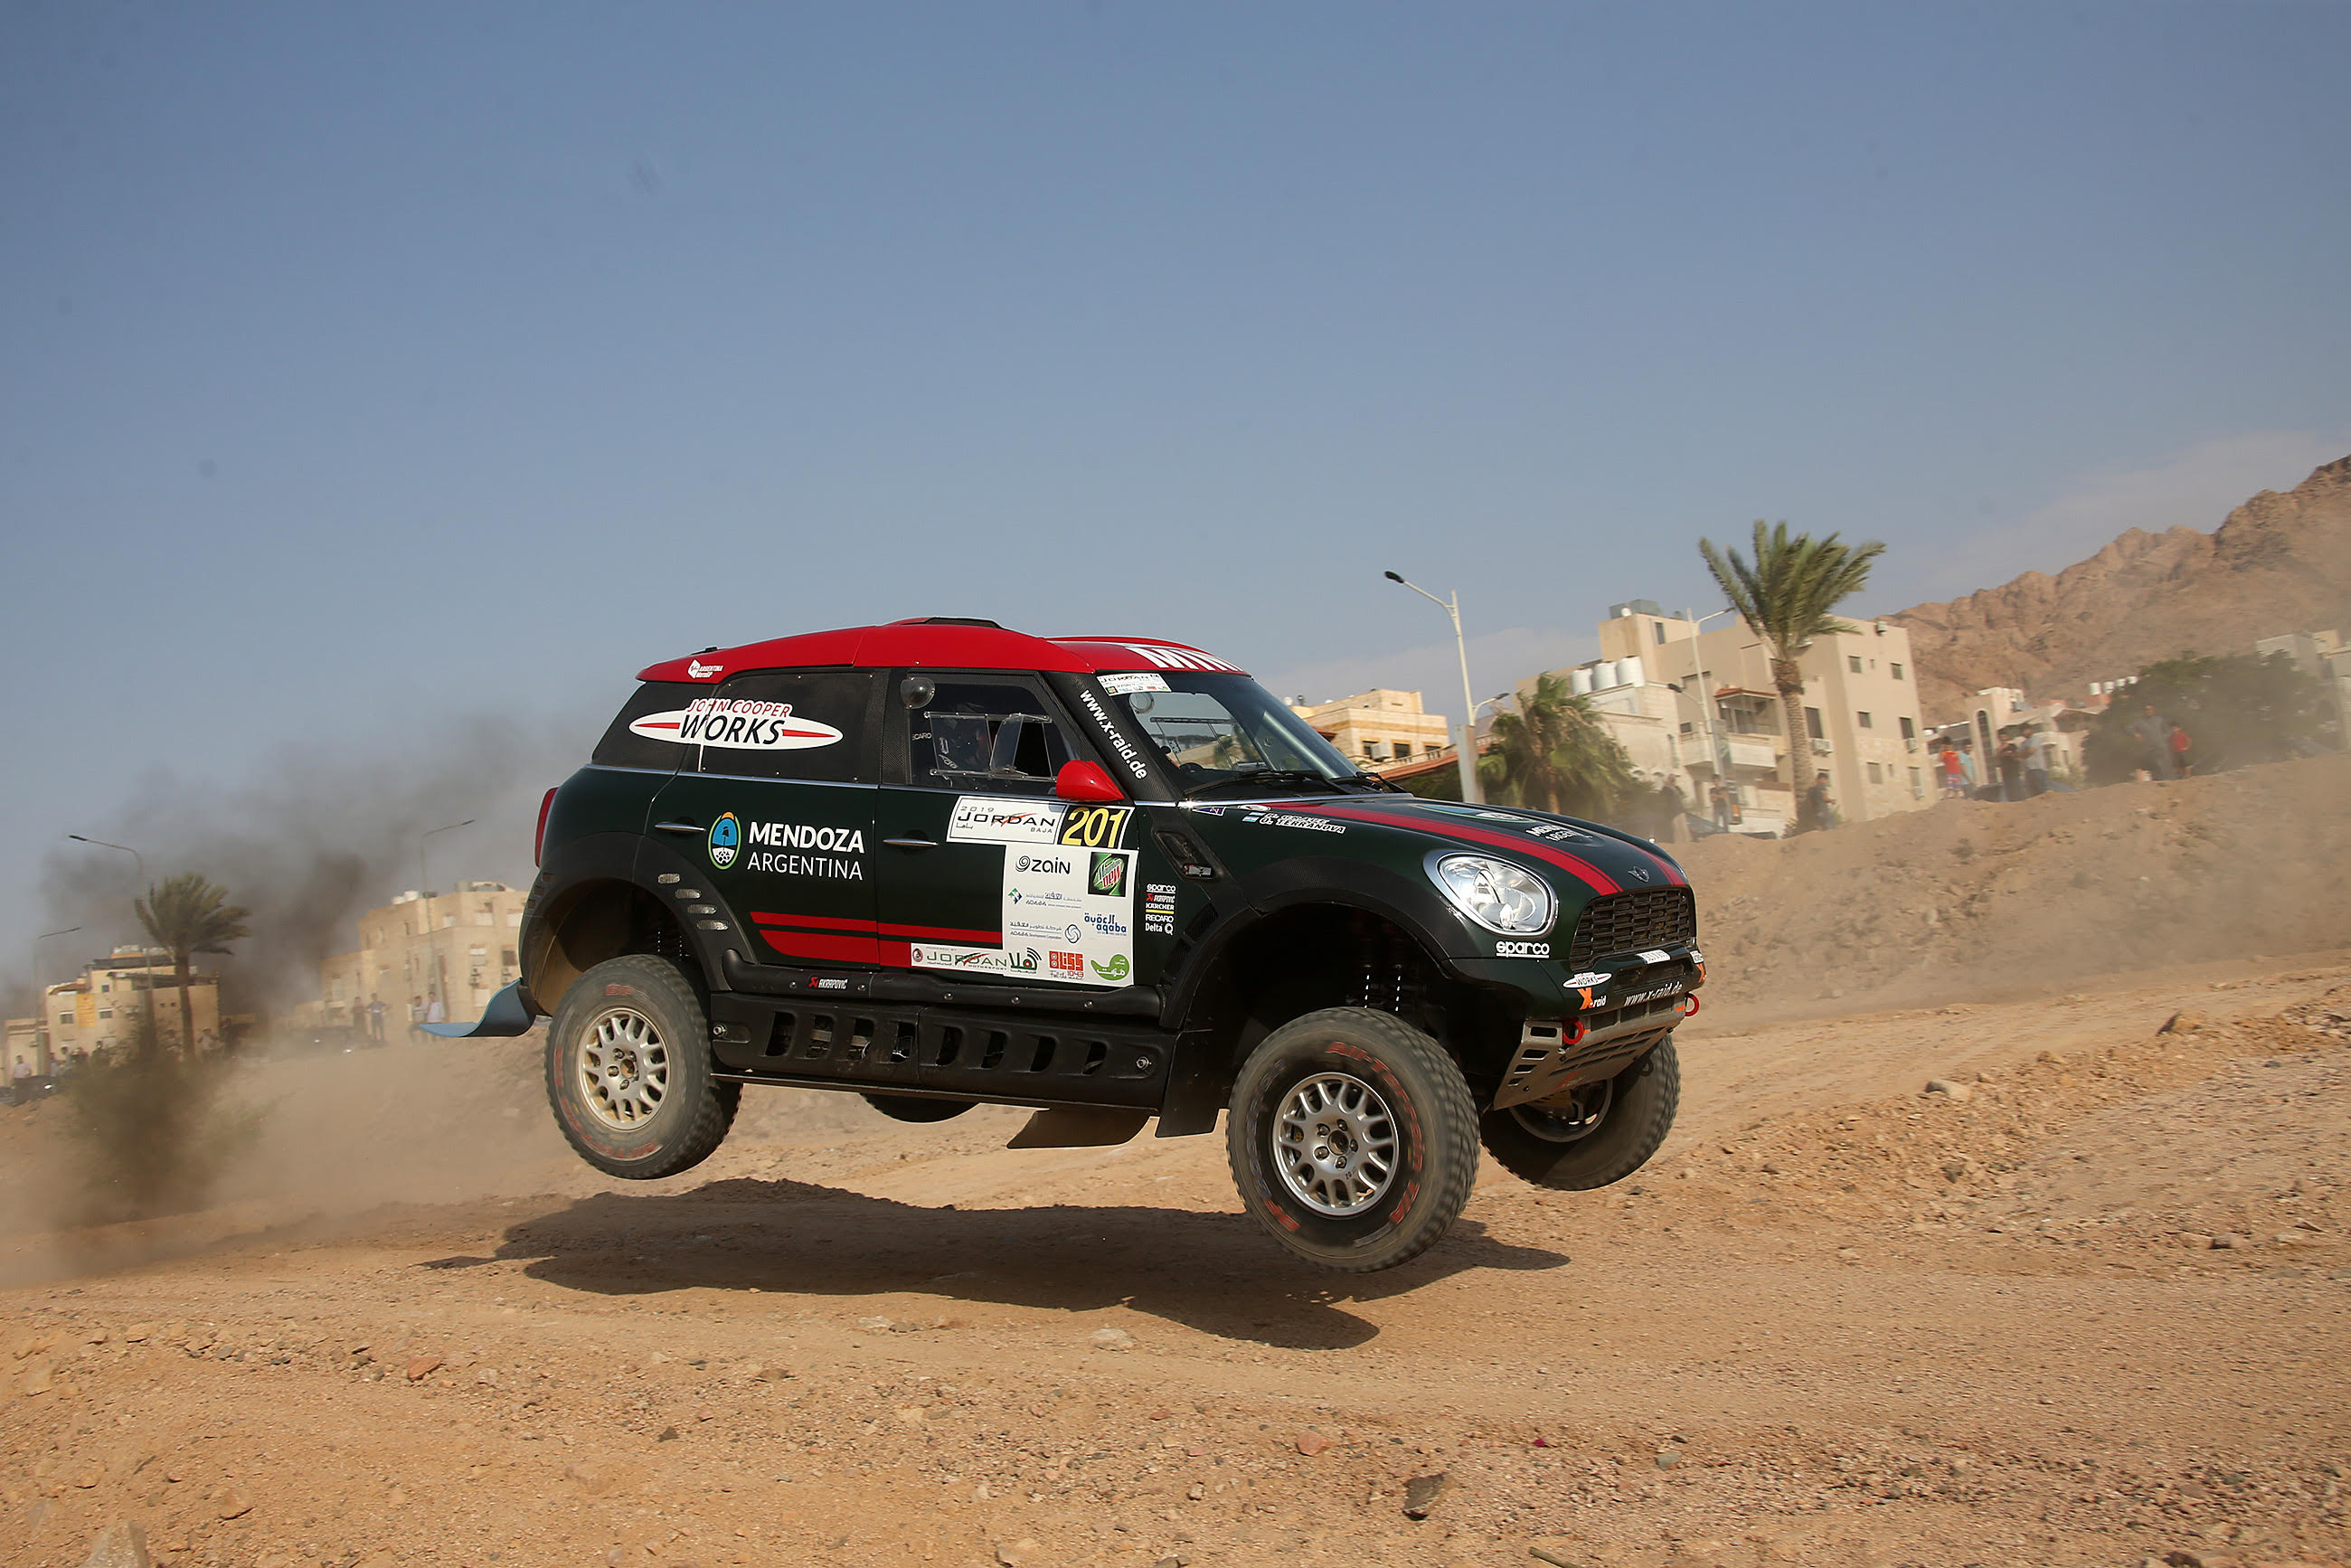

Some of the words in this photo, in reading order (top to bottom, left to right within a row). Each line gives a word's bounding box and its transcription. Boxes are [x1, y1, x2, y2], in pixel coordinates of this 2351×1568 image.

[687, 700, 727, 713] JOHN
[732, 701, 790, 718] COOPER
[680, 714, 785, 745] WORKS
[1080, 690, 1147, 779] www.x-raid.de
[958, 812, 1055, 827] JORDAN
[1062, 807, 1127, 848] 201
[749, 821, 865, 854] MENDOZA
[747, 851, 864, 881] ARGENTINA
[1031, 856, 1071, 874] zain
[1147, 883, 1176, 893] sparco
[1145, 913, 1175, 923] RECARO
[1096, 922, 1127, 935] aqaba
[1496, 940, 1550, 958] sparco
[927, 951, 1007, 967] JORDAN
[1576, 976, 1600, 986] WORKS
